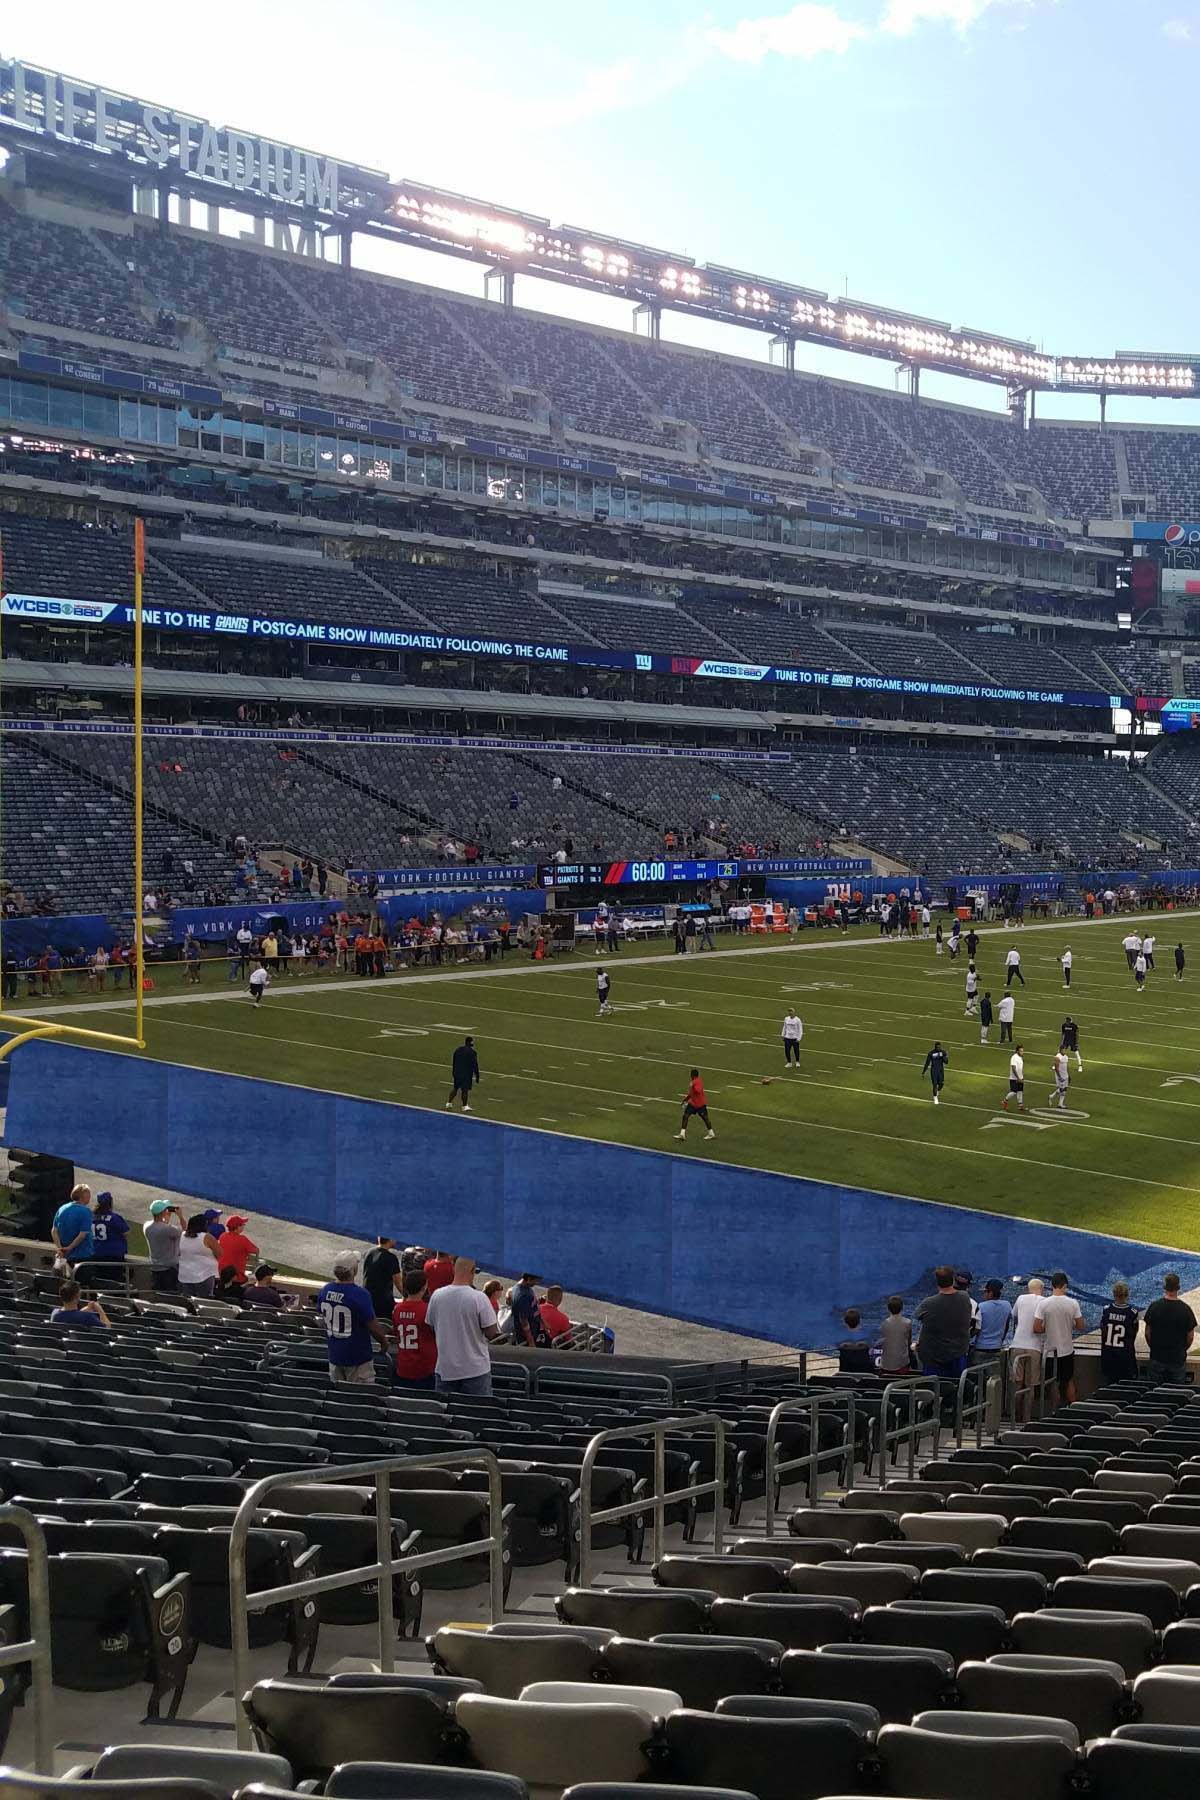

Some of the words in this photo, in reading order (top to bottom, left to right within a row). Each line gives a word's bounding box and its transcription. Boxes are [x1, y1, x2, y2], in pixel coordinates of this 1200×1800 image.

[142, 107, 339, 212] STADIUM
[6, 598, 61, 614] WCBS
[164, 612, 183, 626] TO
[187, 614, 211, 629] THE
[214, 615, 249, 633] GIANTS
[253, 620, 325, 639] POSTGAME
[329, 626, 367, 642] SHOW
[370, 629, 443, 649] IMMEDIATELY
[446, 638, 512, 655] FOLLOWING
[514, 644, 533, 658] THE
[536, 647, 568, 661] GAME
[704, 663, 737, 675] WCBS
[775, 669, 798, 681] TUNE
[799, 672, 812, 683] TO
[814, 673, 829, 684] THE
[855, 677, 902, 691] POSTGAME
[904, 680, 929, 692] SHOW
[930, 683, 980, 697] IMMEDIATELY
[981, 688, 1024, 701] FOLLOWING
[1027, 691, 1039, 702] THE
[1041, 692, 1063, 703] GAME
[558, 866, 578, 874] PATRIOTS
[632, 862, 665, 882] 60:00
[747, 863, 764, 871] NEW
[769, 863, 789, 871] YORK
[794, 862, 831, 870] FOOTBALL
[836, 861, 863, 869] GIANTS
[394, 873, 421, 883] YORK
[429, 872, 481, 882] FOOTBALL
[488, 870, 524, 880] GIANTS
[558, 876, 578, 884] GIANTS
[326, 1290, 345, 1304] CRUZ
[397, 1324, 418, 1350] 12
[1104, 1323, 1126, 1348] 12
